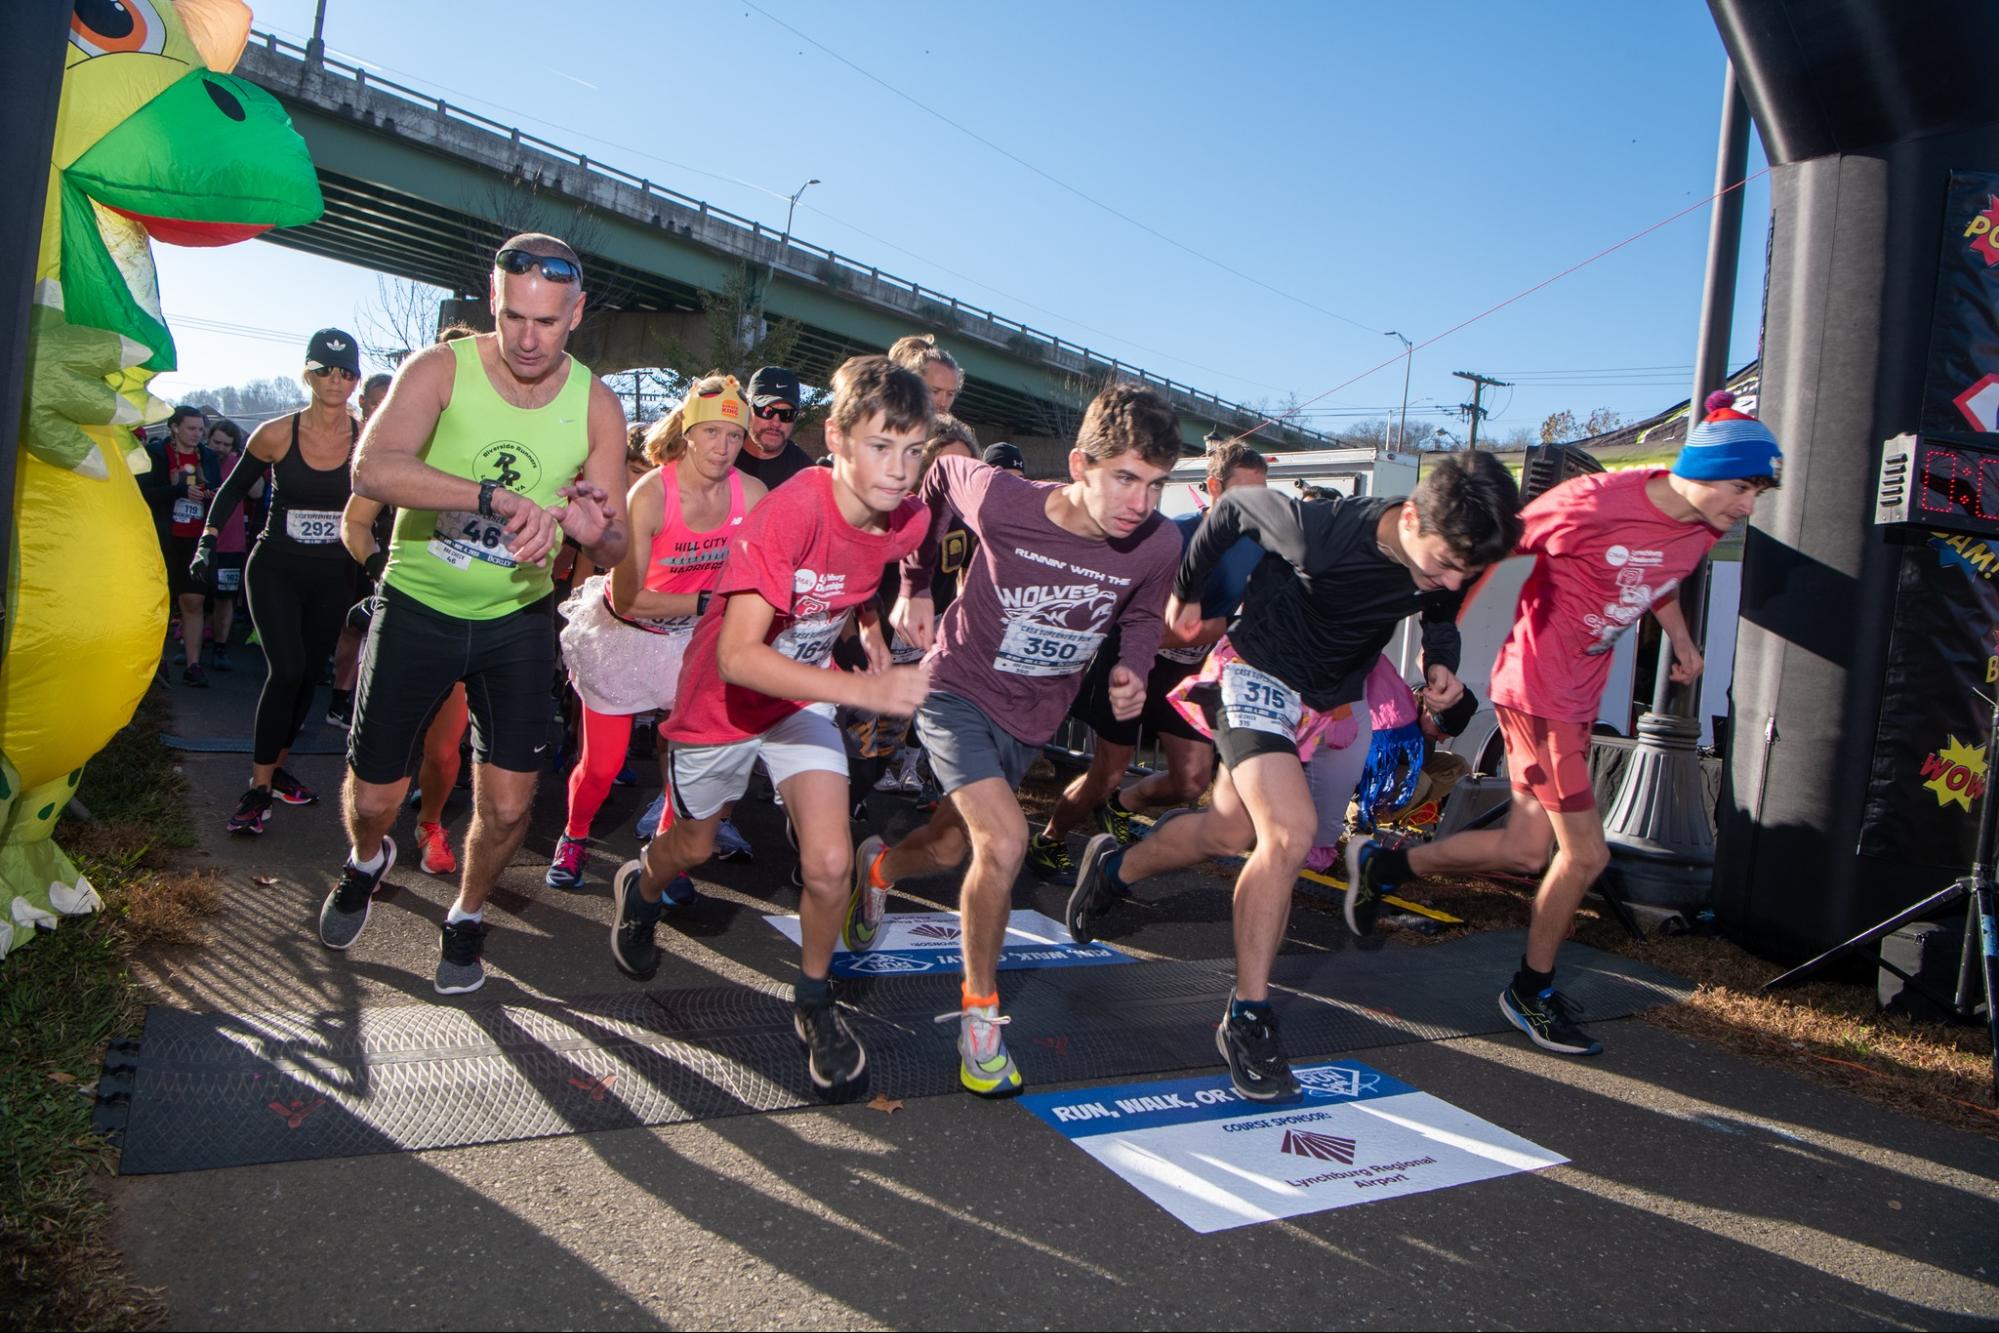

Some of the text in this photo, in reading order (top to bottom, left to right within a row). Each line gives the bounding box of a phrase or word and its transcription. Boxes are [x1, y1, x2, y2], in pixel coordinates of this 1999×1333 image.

[483, 443, 537, 469] Riverside Runners
[301, 522, 335, 537] 292
[463, 520, 501, 549] 46
[675, 537, 728, 552] HILL CITY
[1930, 531, 1999, 579] AM!
[446, 556, 456, 564] 46
[670, 561, 725, 574] HARRIERS
[1015, 548, 1132, 586] RUNNIN' WITH THE
[995, 584, 1098, 608] WOLVES
[1021, 625, 1039, 634] CASA
[1040, 629, 1077, 641] SUPERHERO
[794, 638, 833, 660] 164
[1024, 637, 1077, 659] 350
[1244, 681, 1285, 709] 315
[1052, 1102, 1121, 1122] RUN,
[1115, 1093, 1199, 1114] WALK,
[1194, 1088, 1234, 1104] OR
[1222, 1111, 1332, 1133] COURSE SPONSOR:
[1285, 1156, 1437, 1189] Lynchburg Regional
[1352, 1173, 1410, 1190] Airport
